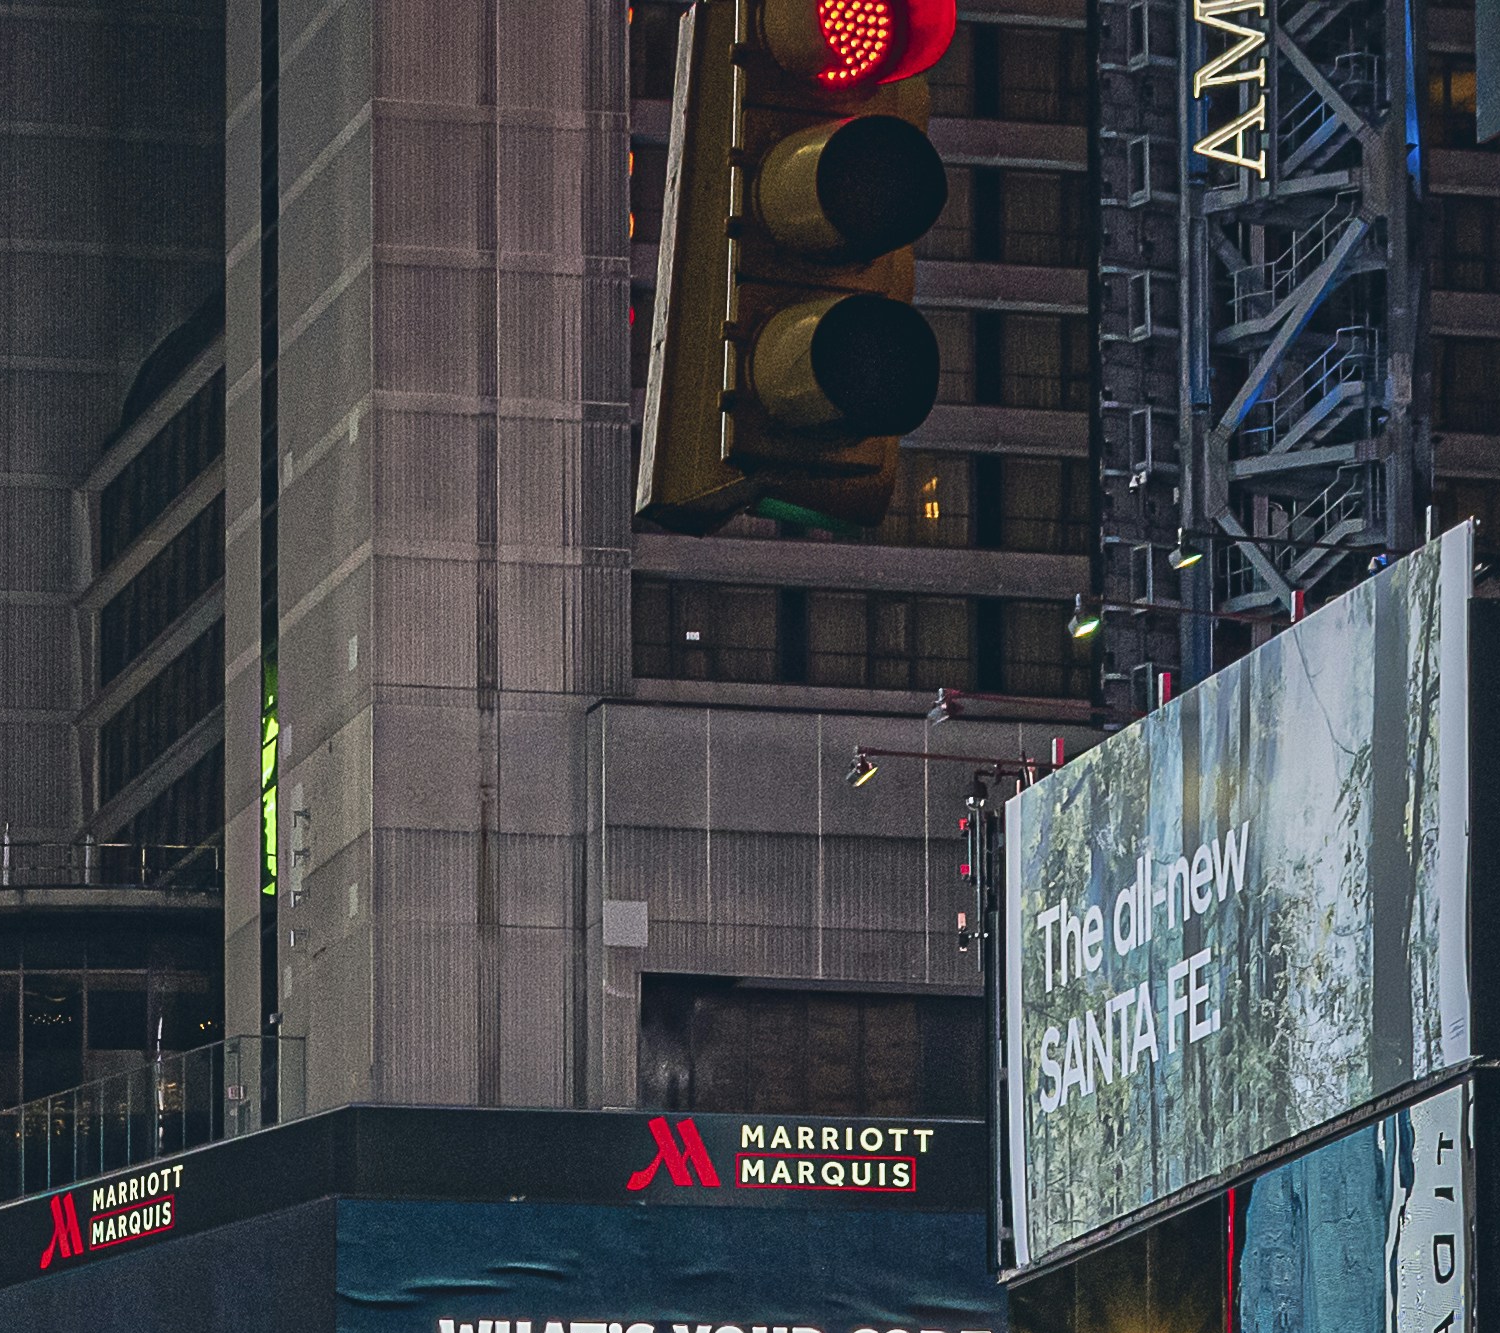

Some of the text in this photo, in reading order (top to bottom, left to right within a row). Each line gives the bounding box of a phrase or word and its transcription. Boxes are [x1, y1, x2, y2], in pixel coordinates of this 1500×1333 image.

[1037, 823, 1250, 993] The all-new
[1040, 947, 1221, 1113] SANTA FE.
[741, 1125, 934, 1152] MARRIOTT
[92, 1164, 184, 1211] MARRIOTT
[742, 1160, 913, 1187] MARQUIS
[92, 1203, 172, 1244] MARQUIS
